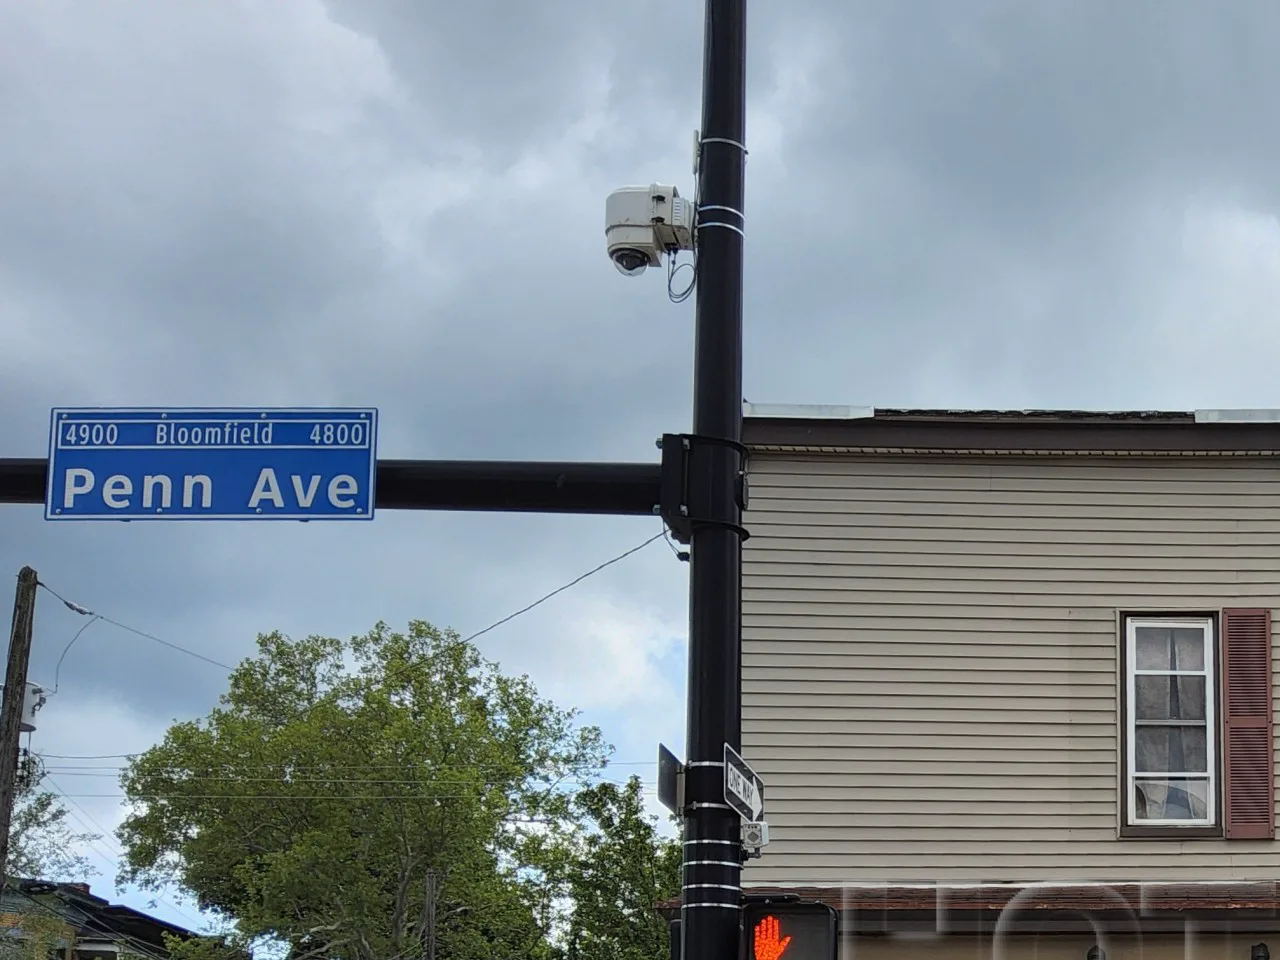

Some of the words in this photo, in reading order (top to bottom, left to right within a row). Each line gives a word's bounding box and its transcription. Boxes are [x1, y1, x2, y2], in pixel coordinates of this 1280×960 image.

[65, 423, 119, 445] 4900
[156, 422, 273, 445] Bloomfield
[310, 423, 363, 445] 4800
[64, 467, 213, 510] Penn
[249, 467, 359, 510] Ave
[729, 766, 741, 794] ONE
[742, 778, 754, 807] WAY
